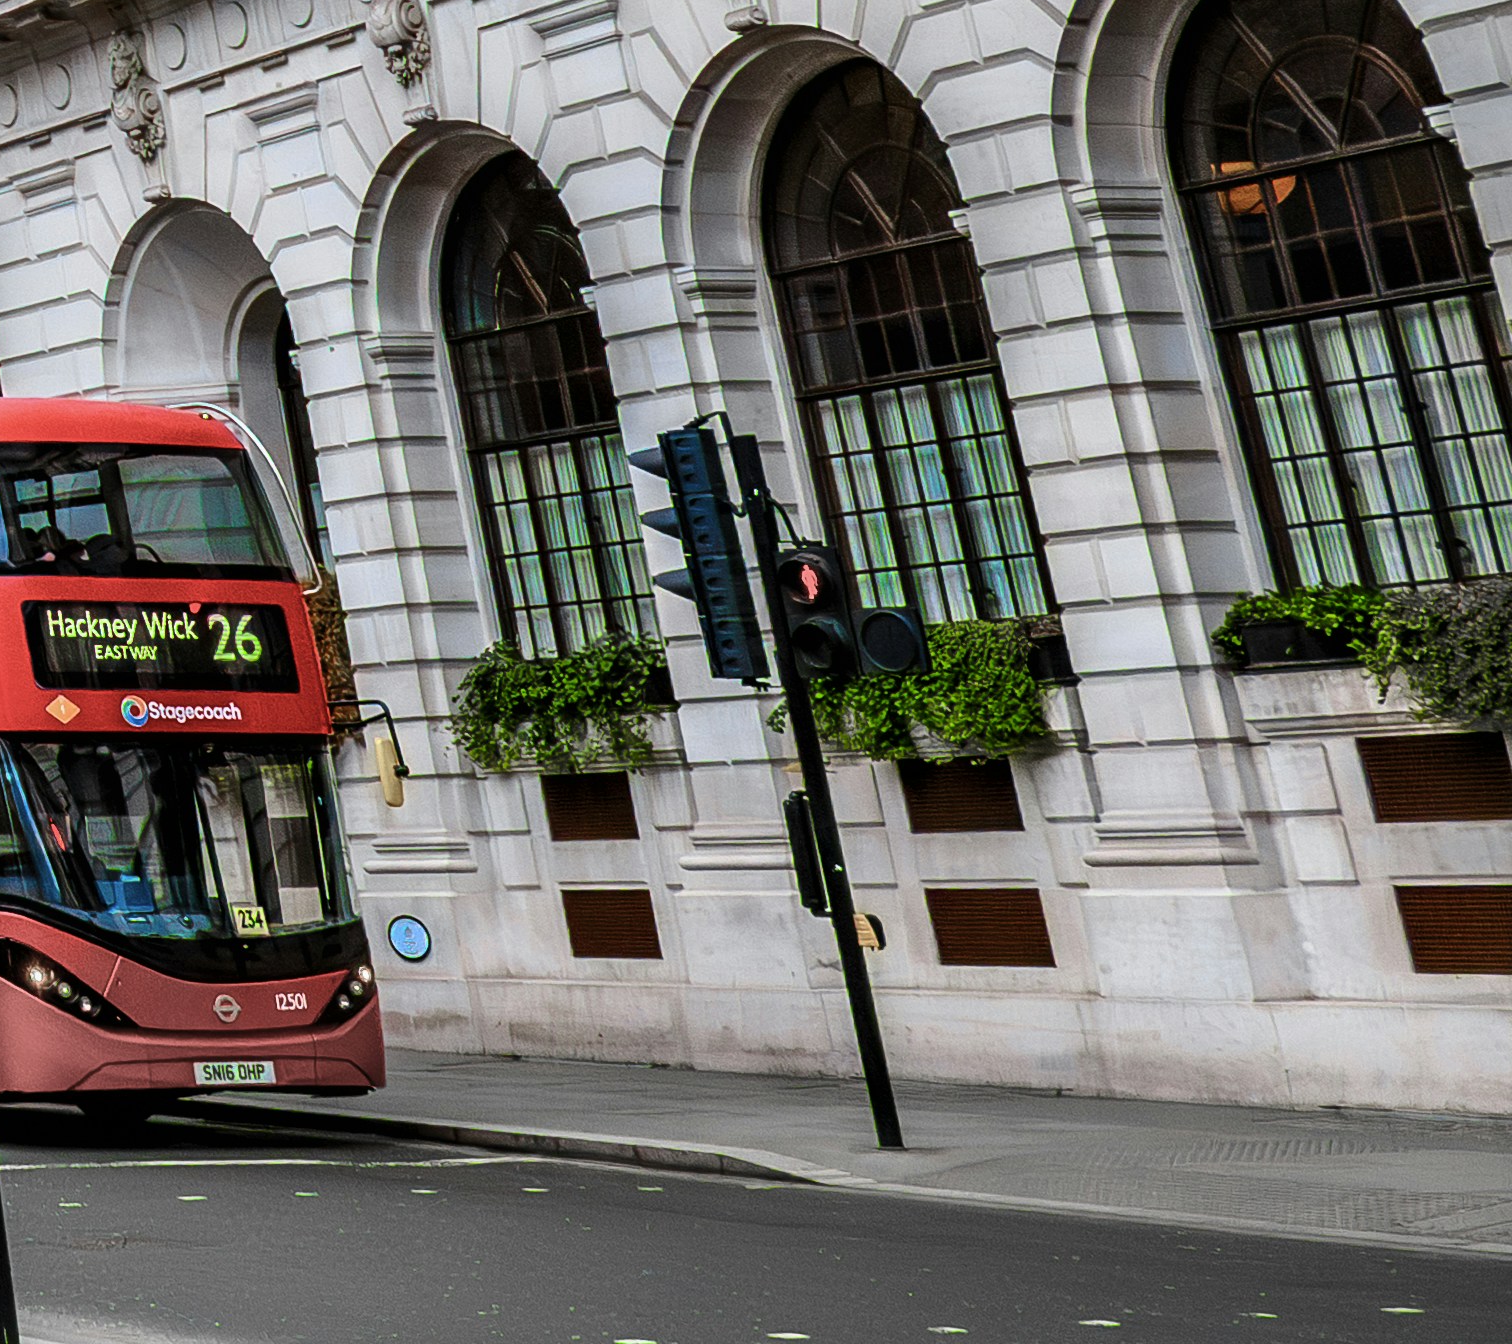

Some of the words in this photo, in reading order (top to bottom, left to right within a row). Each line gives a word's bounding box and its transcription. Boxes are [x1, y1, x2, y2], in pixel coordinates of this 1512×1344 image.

[47, 609, 138, 645] Hackney
[142, 611, 199, 640] Wick
[208, 613, 263, 662] 26
[94, 644, 158, 661] EASTWAY
[148, 700, 243, 724] Stagecoach
[237, 909, 264, 929] 234
[275, 992, 308, 1010] 12501
[202, 1063, 236, 1081] SN16
